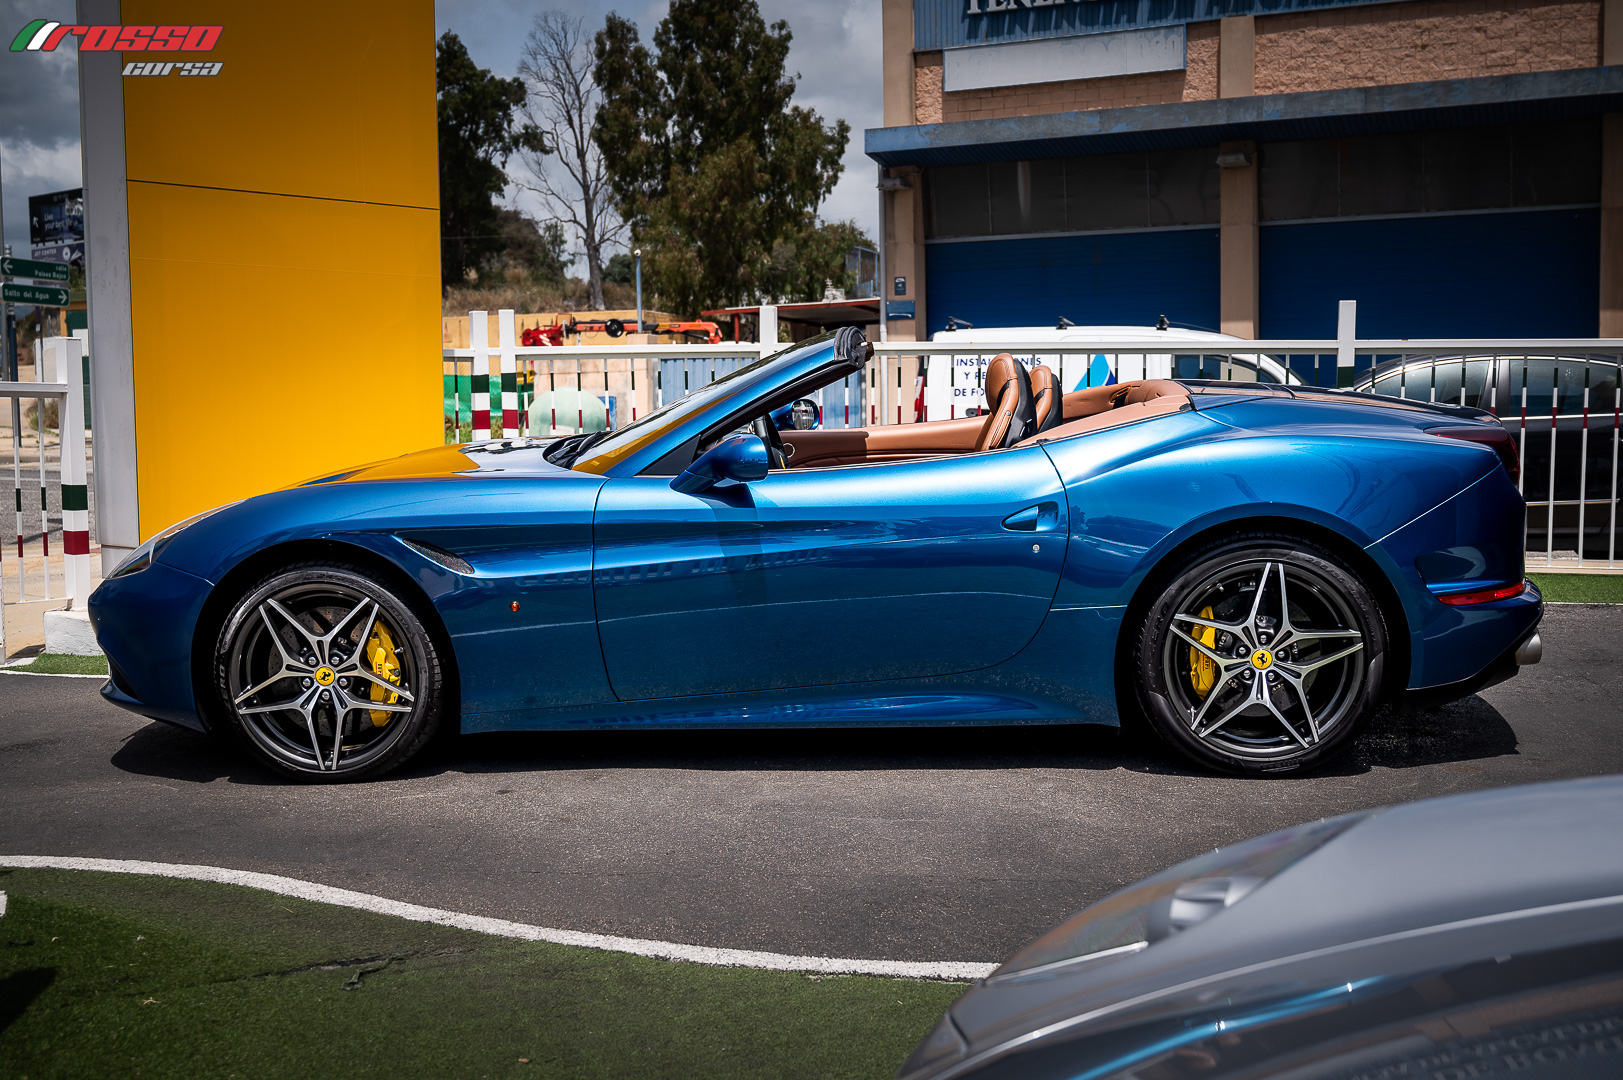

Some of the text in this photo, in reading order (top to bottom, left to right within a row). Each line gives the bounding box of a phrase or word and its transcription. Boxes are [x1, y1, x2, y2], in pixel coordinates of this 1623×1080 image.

[4, 289, 49, 301] Salto del Agua
[954, 388, 967, 396] DE
